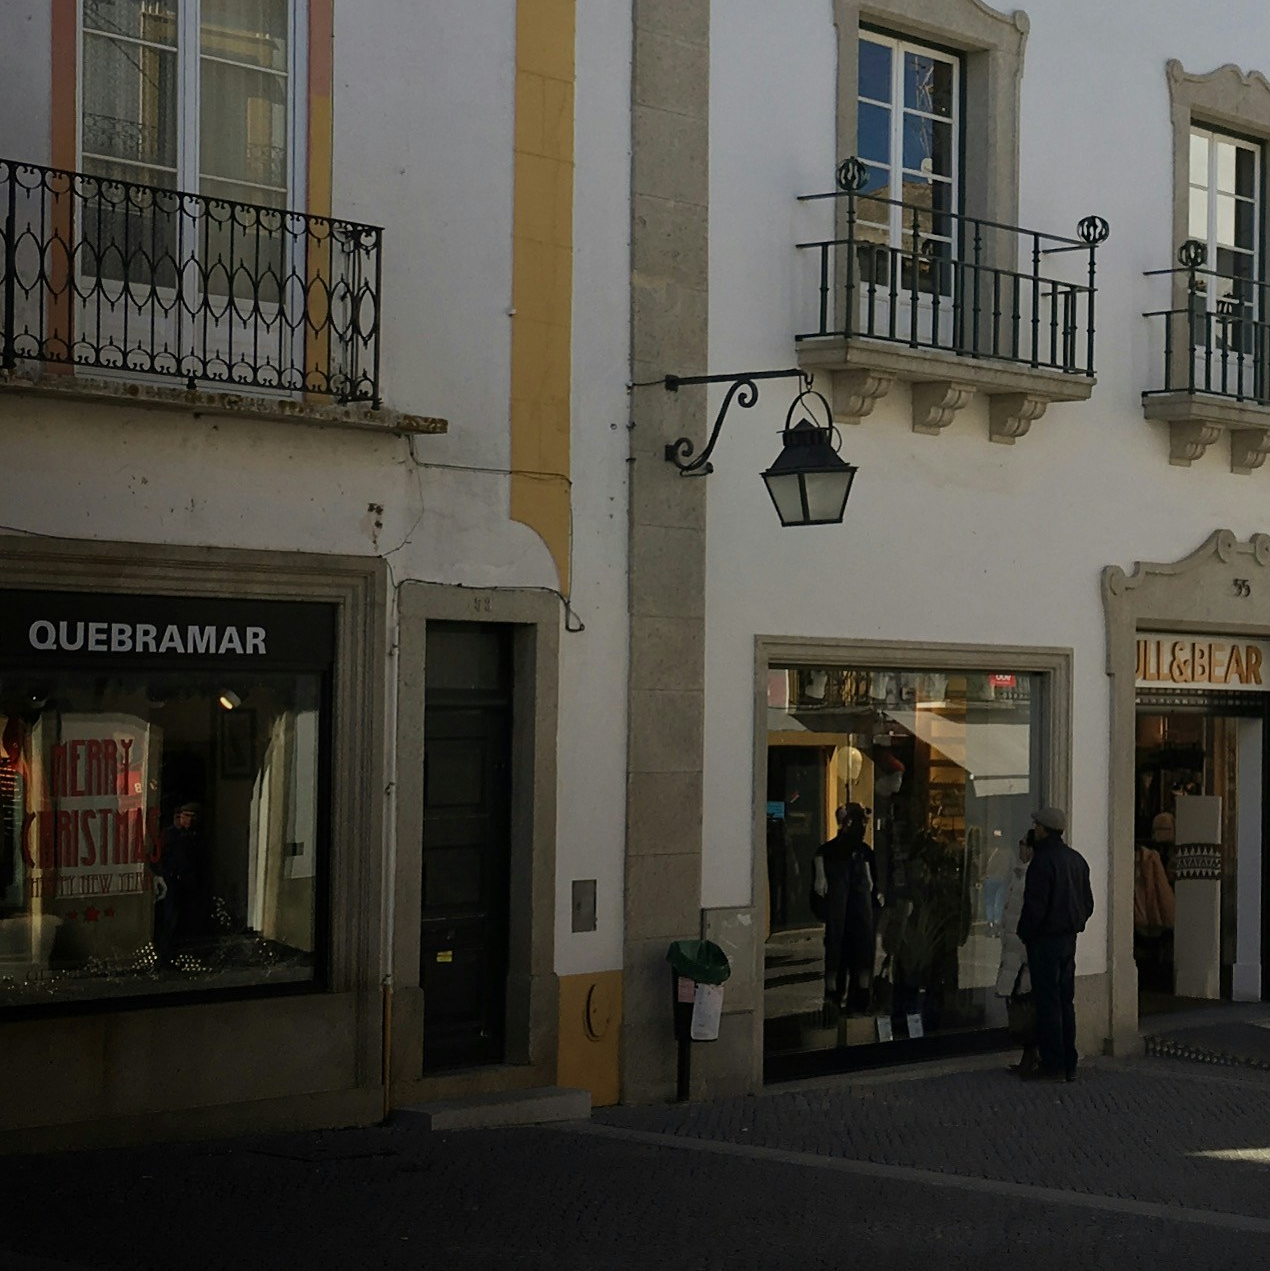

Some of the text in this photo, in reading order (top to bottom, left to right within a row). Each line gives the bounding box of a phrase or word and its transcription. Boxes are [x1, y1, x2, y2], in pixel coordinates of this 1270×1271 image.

[1233, 578, 1251, 598] 55
[28, 619, 267, 655] QUEBRAMAR
[50, 738, 134, 798] MERRY
[21, 806, 161, 869] CHRISTMAS
